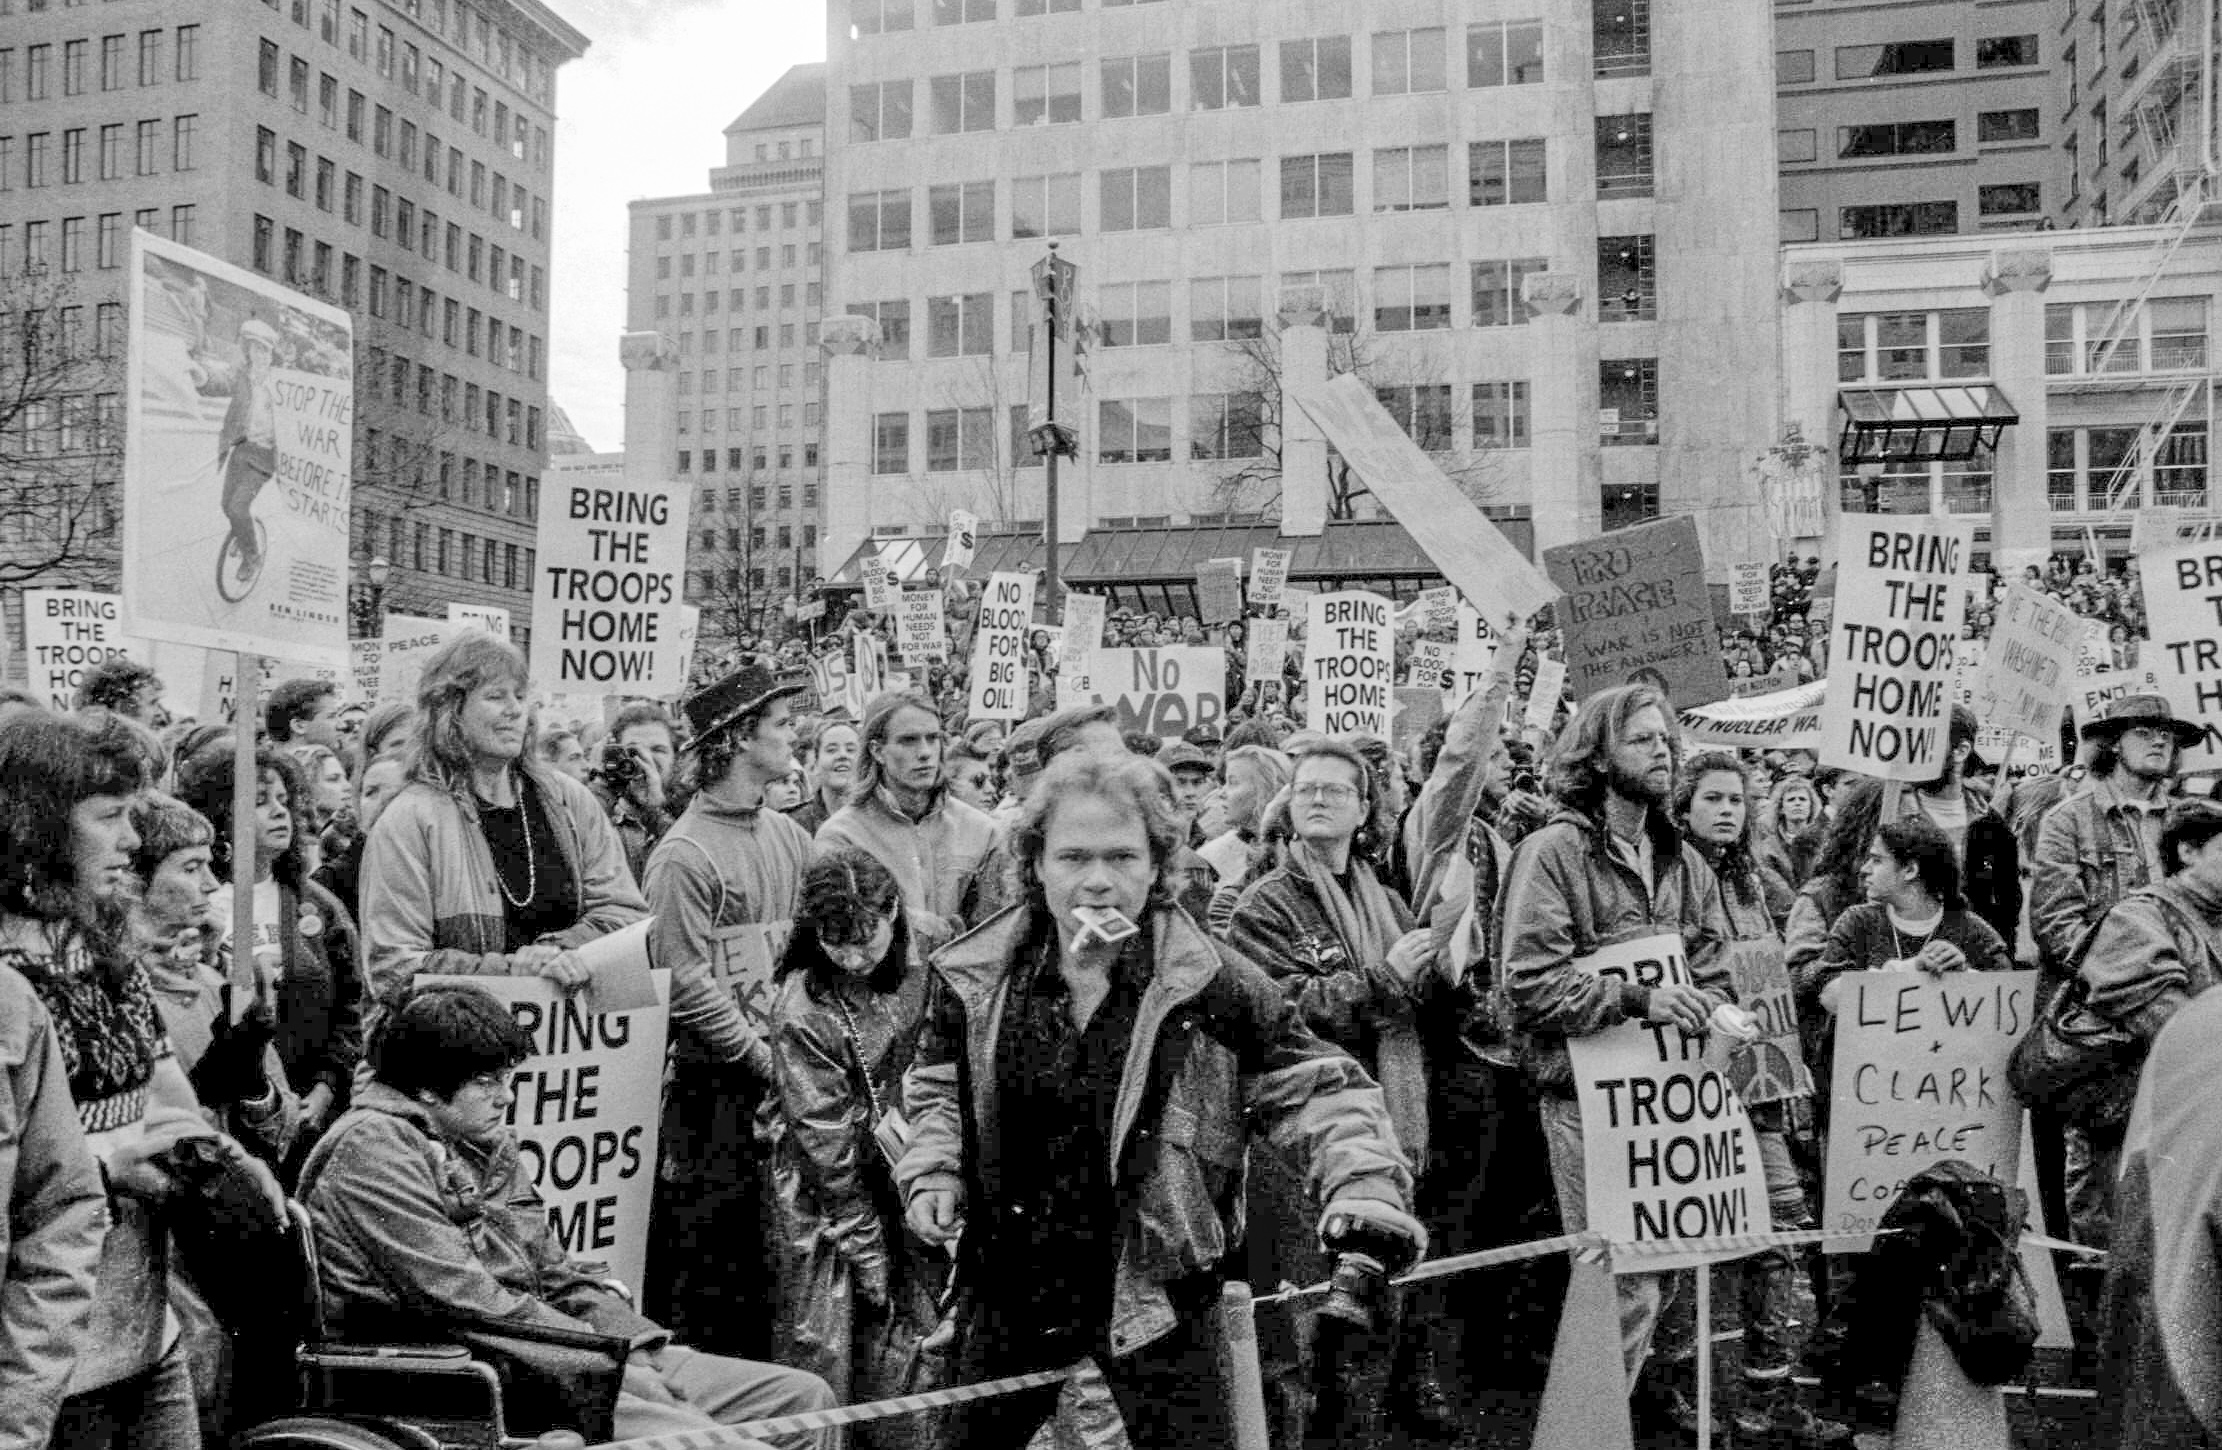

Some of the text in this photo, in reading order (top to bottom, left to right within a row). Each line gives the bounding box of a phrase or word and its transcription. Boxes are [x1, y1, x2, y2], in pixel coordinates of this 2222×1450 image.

[275, 379, 350, 425] STOP THE
[298, 421, 342, 459] WAR
[279, 453, 334, 497] BEFORE
[287, 487, 350, 536] STARTS
[569, 487, 668, 525] BRING
[588, 528, 649, 564] THE
[1868, 530, 1959, 575] BRING
[547, 567, 673, 604] TROOPS
[901, 592, 934, 602] MONEY
[997, 581, 1020, 604] NO
[46, 598, 116, 620] BRING
[910, 603, 928, 611] FOR
[1325, 600, 1386, 627] BRING
[1424, 606, 1457, 616] TROOPS
[1885, 580, 1947, 622] THE
[561, 608, 658, 642] HOME
[902, 612, 937, 621] HUMAN
[905, 622, 935, 631] NEEDS
[60, 622, 105, 642] THE
[388, 634, 440, 652] PEACE
[911, 632, 930, 640] NOT
[1336, 627, 1377, 652] THE
[1583, 618, 1709, 657] WAR IS NOT
[351, 642, 381, 652] MON
[363, 653, 381, 663] FO
[901, 642, 942, 651] FOR WAR
[989, 635, 1019, 657] FOR
[1424, 645, 1441, 657] NO
[1843, 623, 1955, 671] TROOPS
[561, 648, 654, 681] NOW!
[989, 662, 1014, 683] BIG
[1314, 655, 1391, 683] TROOPS
[1413, 656, 1445, 670] BLOOD
[1416, 669, 1438, 681] FOR
[1582, 660, 1615, 679] THE
[49, 669, 88, 688] HO
[983, 687, 1014, 709] OIL!
[1325, 683, 1386, 709] HOME
[1853, 672, 1943, 718] HOME
[2085, 686, 2126, 709] END
[1326, 711, 1385, 735] NOW!
[1708, 717, 1789, 735] NUCLEAR
[1792, 714, 1822, 732] WA
[1849, 718, 1936, 764] NOW!
[1859, 984, 2021, 1036] LEWIS
[510, 998, 630, 1056] RING
[1640, 1018, 1707, 1062] TH
[505, 1065, 600, 1126] THE
[1856, 1063, 1995, 1108] CLARK
[1594, 1071, 1743, 1128] TROOP
[1857, 1122, 1985, 1156] PEACE
[518, 1125, 643, 1191] OOPS
[1627, 1128, 1746, 1189] HOME
[548, 1195, 618, 1252] ME
[1633, 1187, 1748, 1241] NOW!
